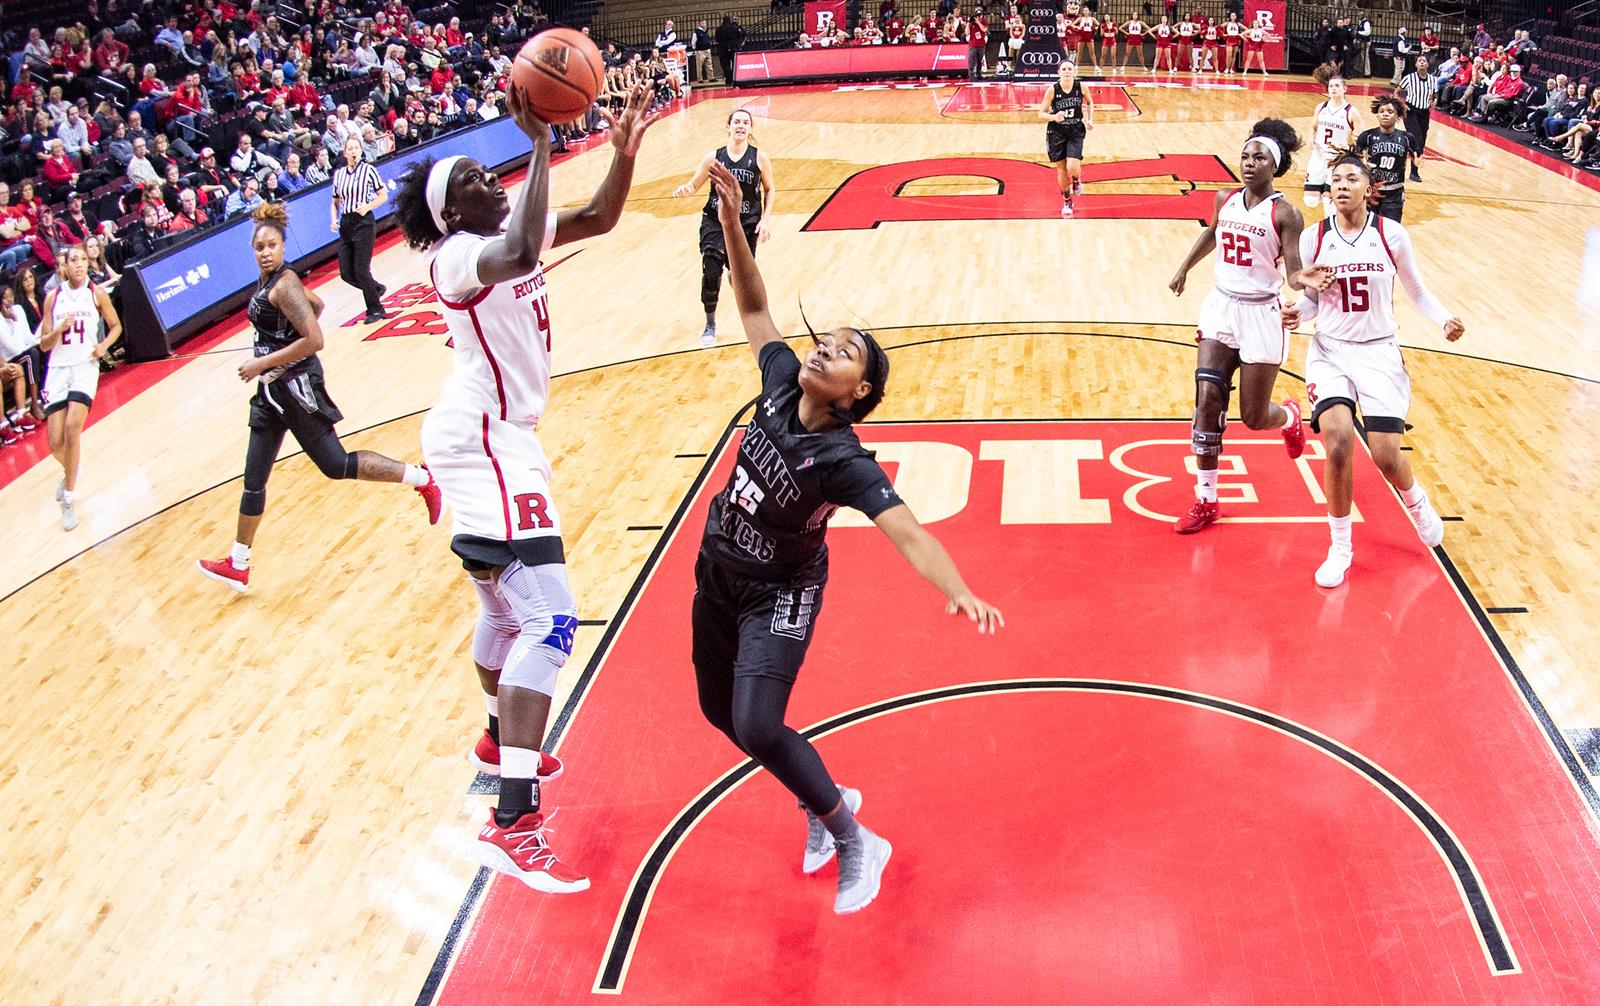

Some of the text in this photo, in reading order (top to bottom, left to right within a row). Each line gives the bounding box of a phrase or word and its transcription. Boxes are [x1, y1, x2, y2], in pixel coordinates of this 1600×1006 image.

[1256, 10, 1275, 27] R
[1324, 128, 1334, 145] 2
[1372, 141, 1405, 157] SAINT
[1380, 156, 1396, 170] 00
[1221, 231, 1253, 267] 22
[1327, 263, 1385, 276] UTGERS
[1337, 275, 1370, 313] 15
[61, 319, 85, 346] 24
[513, 492, 554, 531] R
